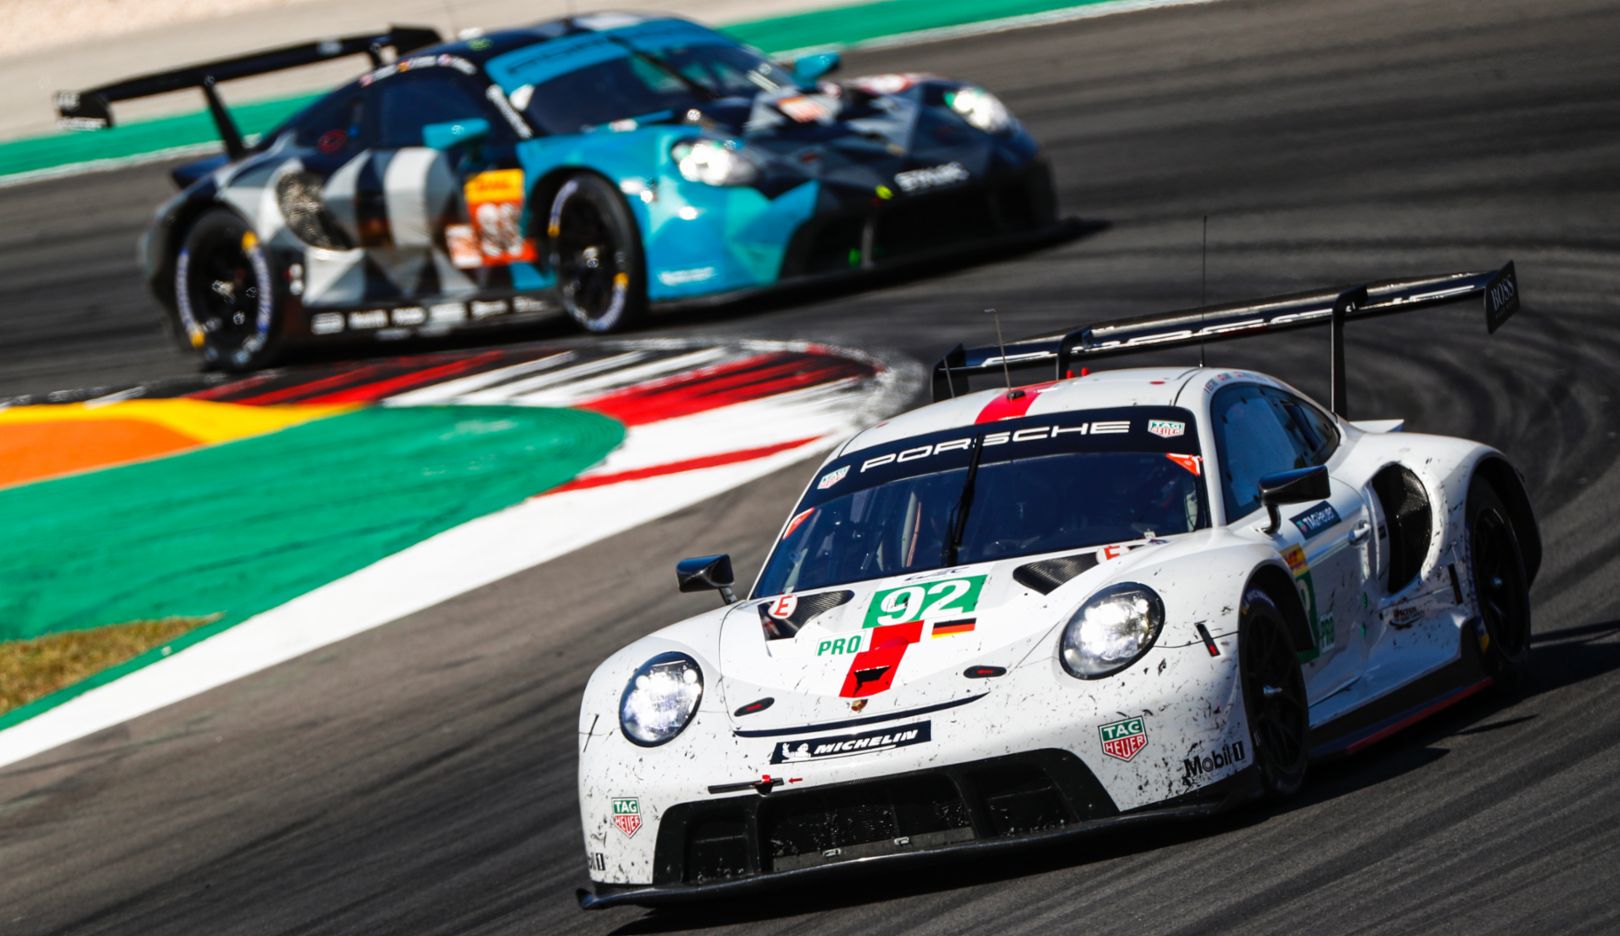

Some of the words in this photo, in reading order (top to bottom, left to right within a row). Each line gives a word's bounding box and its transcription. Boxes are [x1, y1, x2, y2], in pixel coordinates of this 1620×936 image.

[1490, 278, 1515, 311] BOSS
[860, 420, 1131, 473] PORSCHE
[774, 595, 793, 616] E
[877, 579, 972, 625] 92
[817, 635, 862, 656] PRO
[1104, 721, 1142, 739] TAG
[814, 730, 919, 755] MICHELIN
[1105, 736, 1145, 758] HEUER
[1184, 744, 1232, 778] Mobil
[1234, 741, 1245, 761] 1
[614, 801, 637, 813] TAG
[614, 815, 640, 834] HEUER
